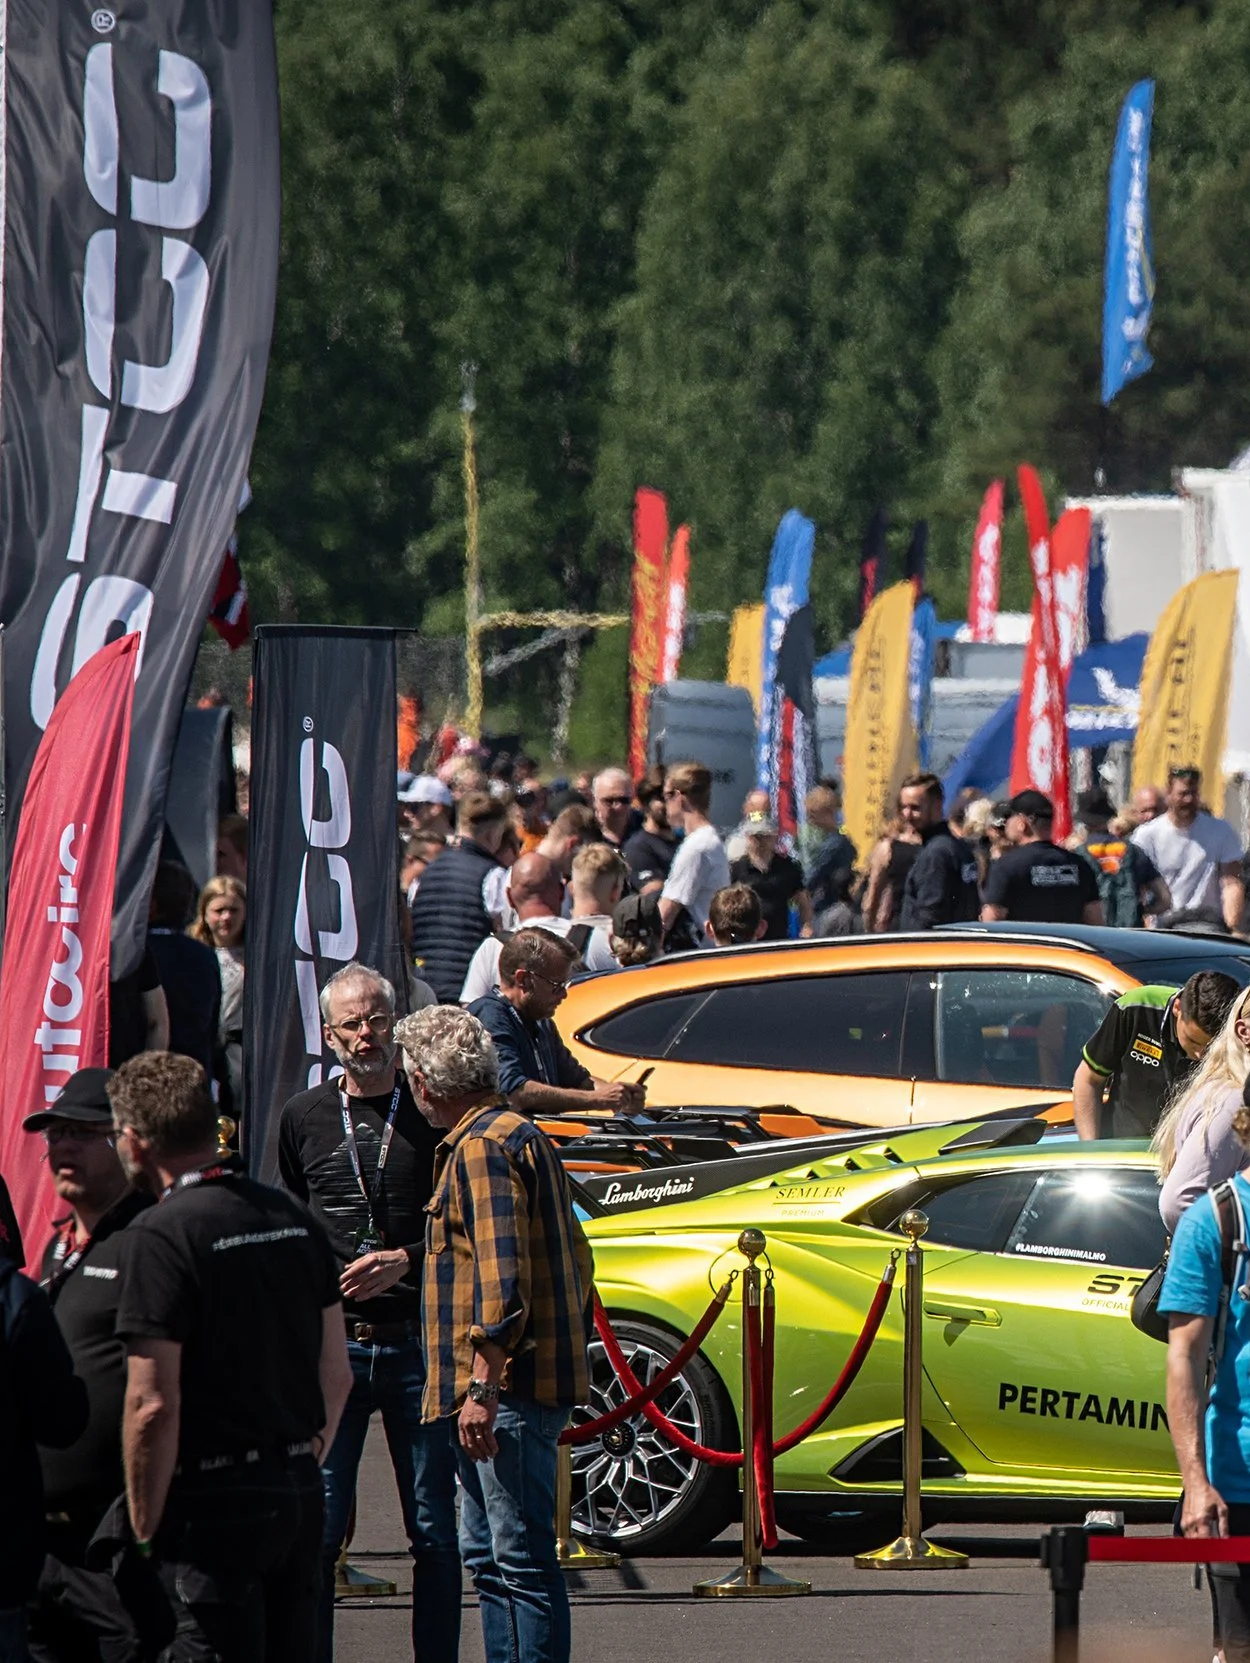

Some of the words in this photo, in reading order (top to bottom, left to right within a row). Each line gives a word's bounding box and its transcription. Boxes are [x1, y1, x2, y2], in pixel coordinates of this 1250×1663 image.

[34, 822, 88, 1110] utocirc
[1130, 1050, 1160, 1067] oppo
[598, 1177, 695, 1205] Lamborghini
[776, 1186, 846, 1200] SEMLER
[781, 1209, 825, 1217] PREMIUM
[1015, 1242, 1107, 1262] #LAMBORGHINIMALMO
[1081, 1298, 1130, 1312] OFFICIAL
